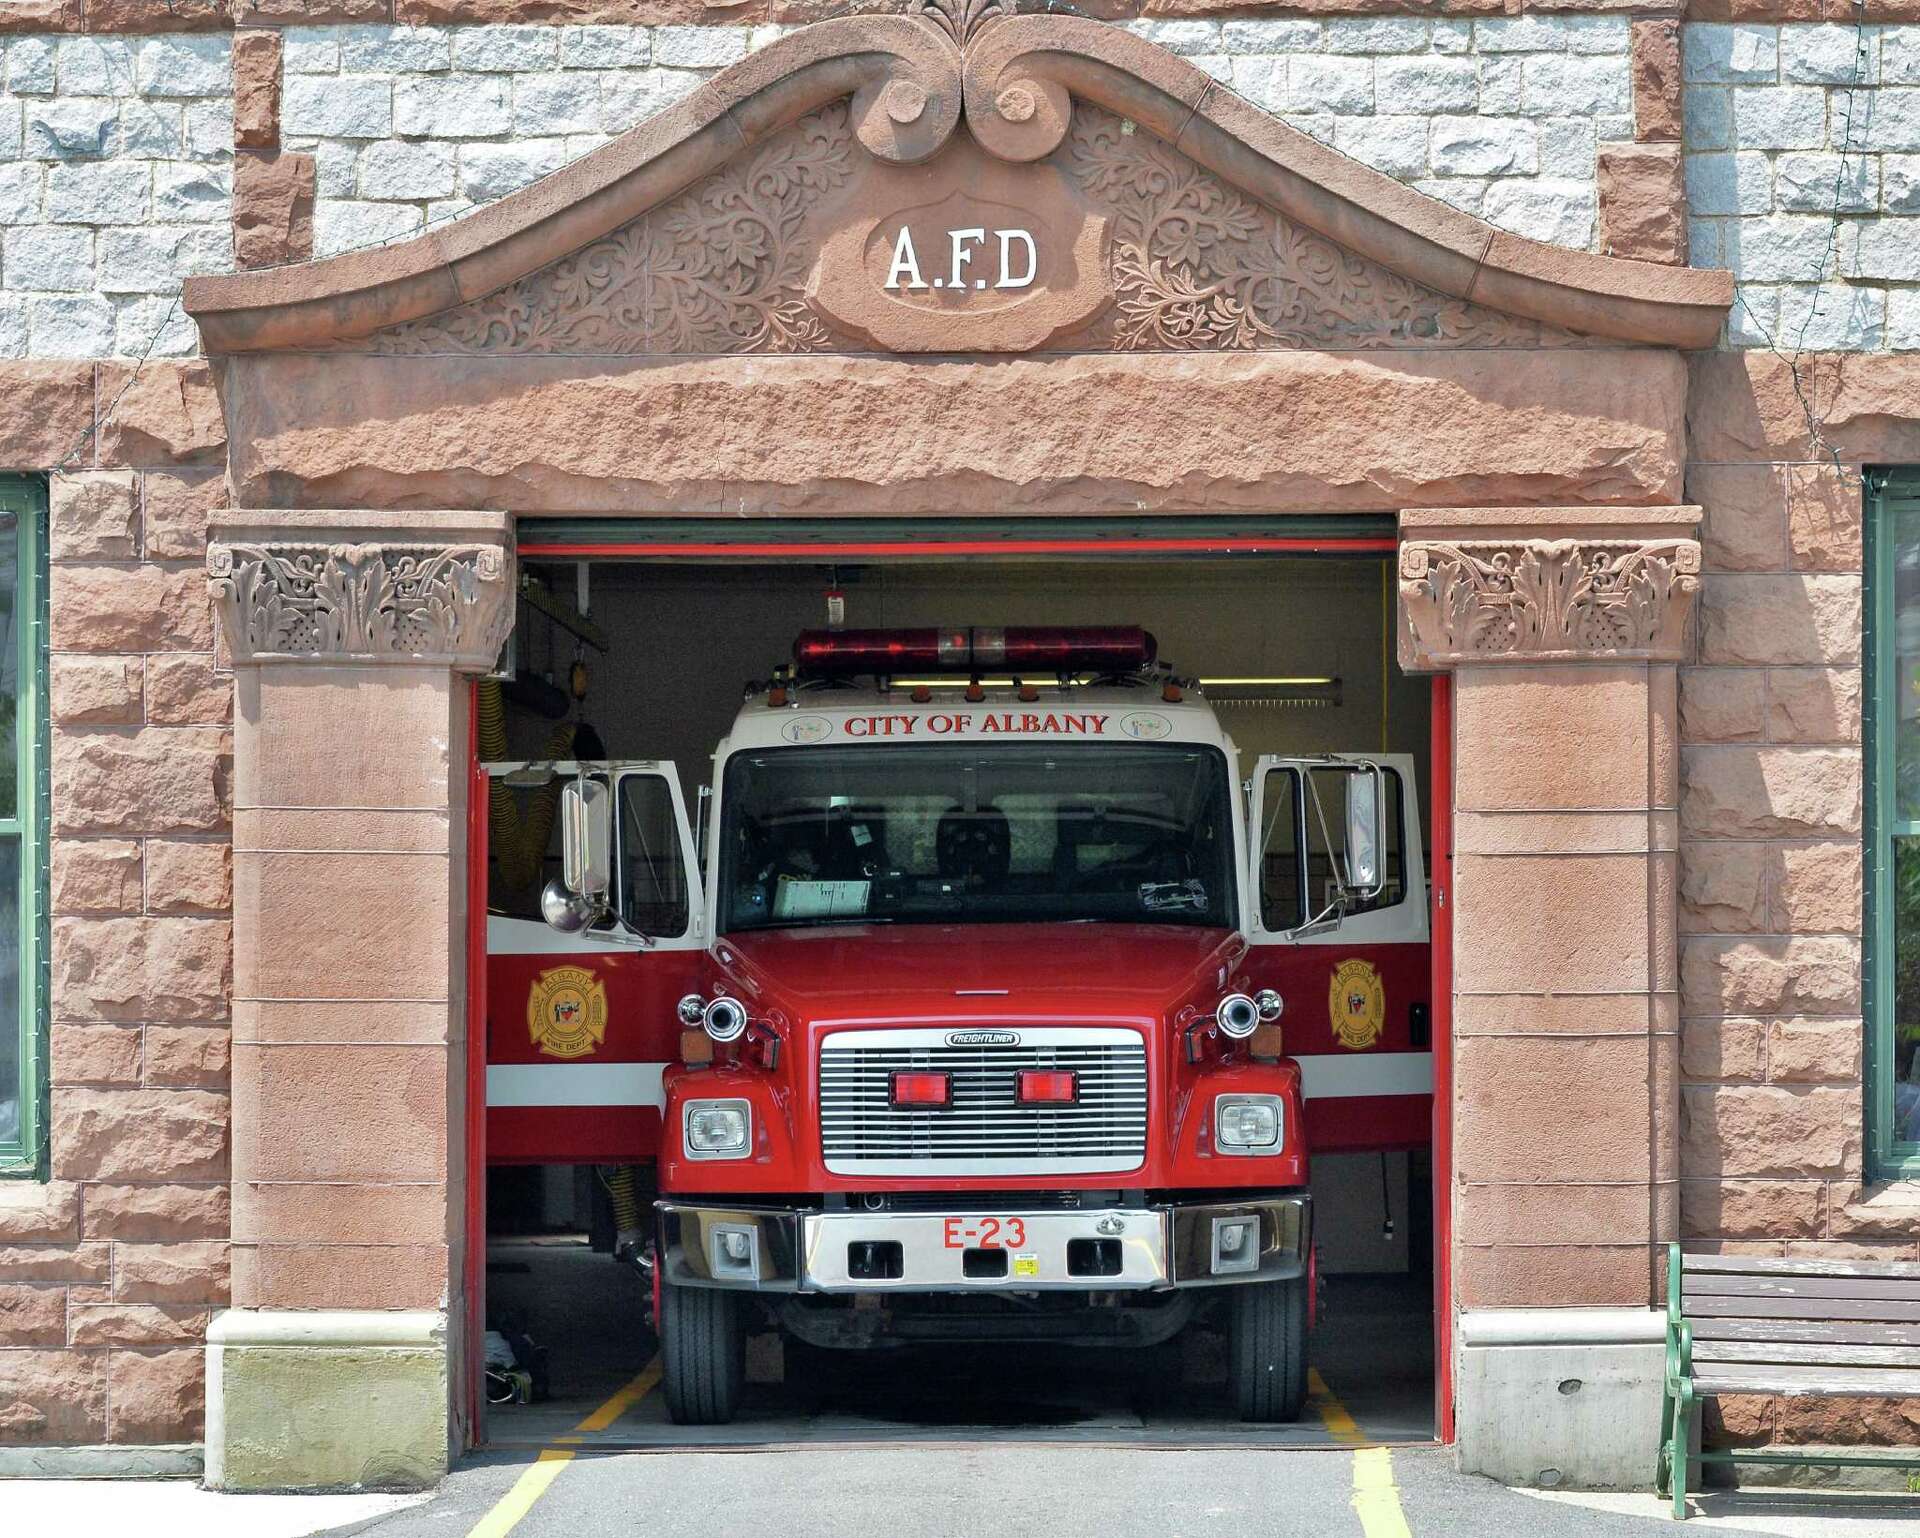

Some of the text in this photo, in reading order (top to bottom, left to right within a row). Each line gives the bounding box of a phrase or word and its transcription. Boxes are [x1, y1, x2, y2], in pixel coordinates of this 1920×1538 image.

[884, 225, 1037, 289] A.F.D
[843, 713, 1110, 737] CITY OF ALBANY
[545, 971, 594, 989] ALBANY
[546, 1037, 586, 1051] FIRE DEPT
[953, 1033, 1012, 1043] FREIGHTLINER
[945, 1217, 1025, 1248] E-23
